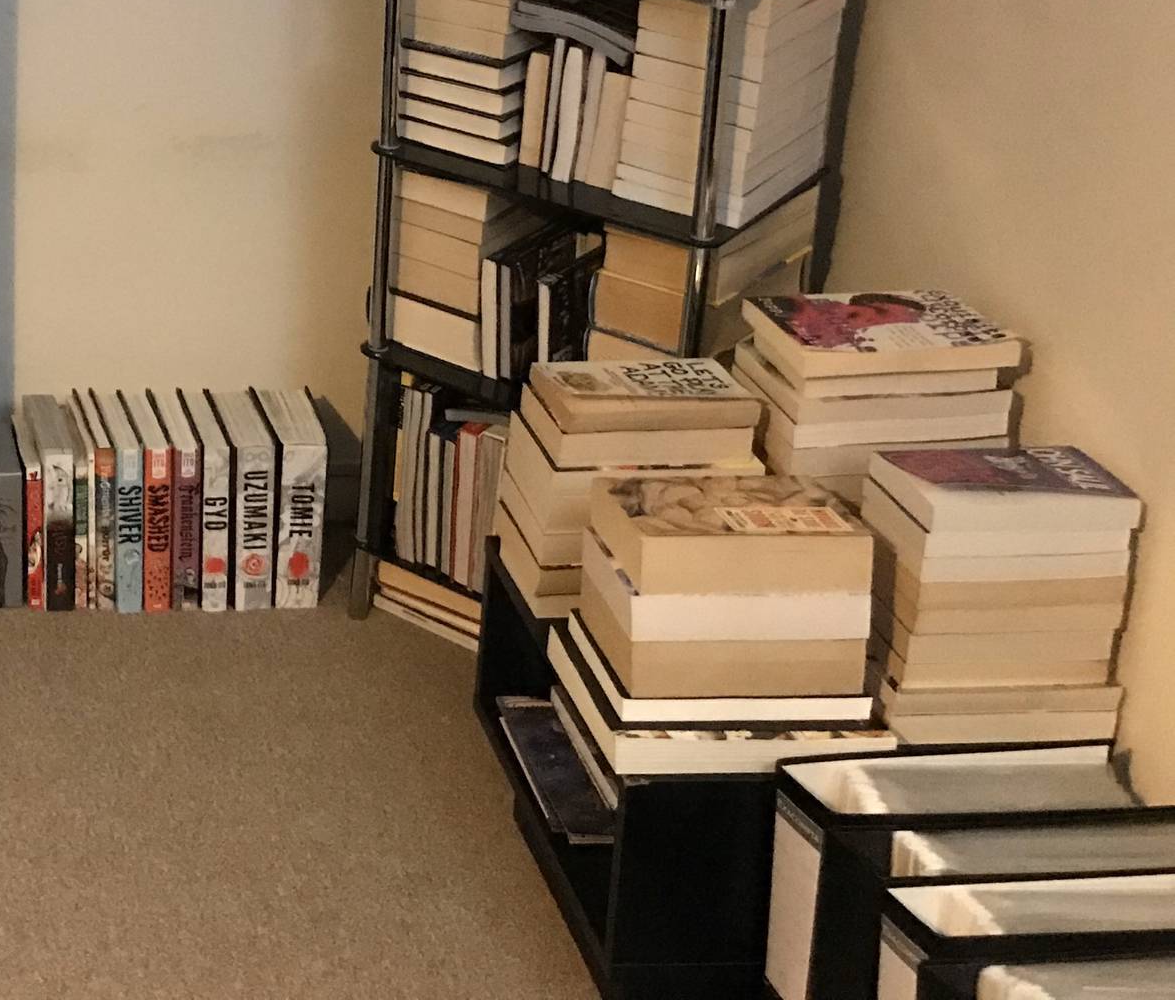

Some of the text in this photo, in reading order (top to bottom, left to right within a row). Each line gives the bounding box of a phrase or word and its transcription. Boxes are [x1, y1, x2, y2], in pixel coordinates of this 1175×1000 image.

[639, 362, 673, 379] AT
[662, 361, 689, 376] GO
[118, 485, 142, 544] SHIVER
[147, 484, 170, 553] SMASHED
[204, 497, 228, 531] GYO
[243, 470, 268, 550] UZUMAKI
[289, 484, 315, 538] TOMIE
